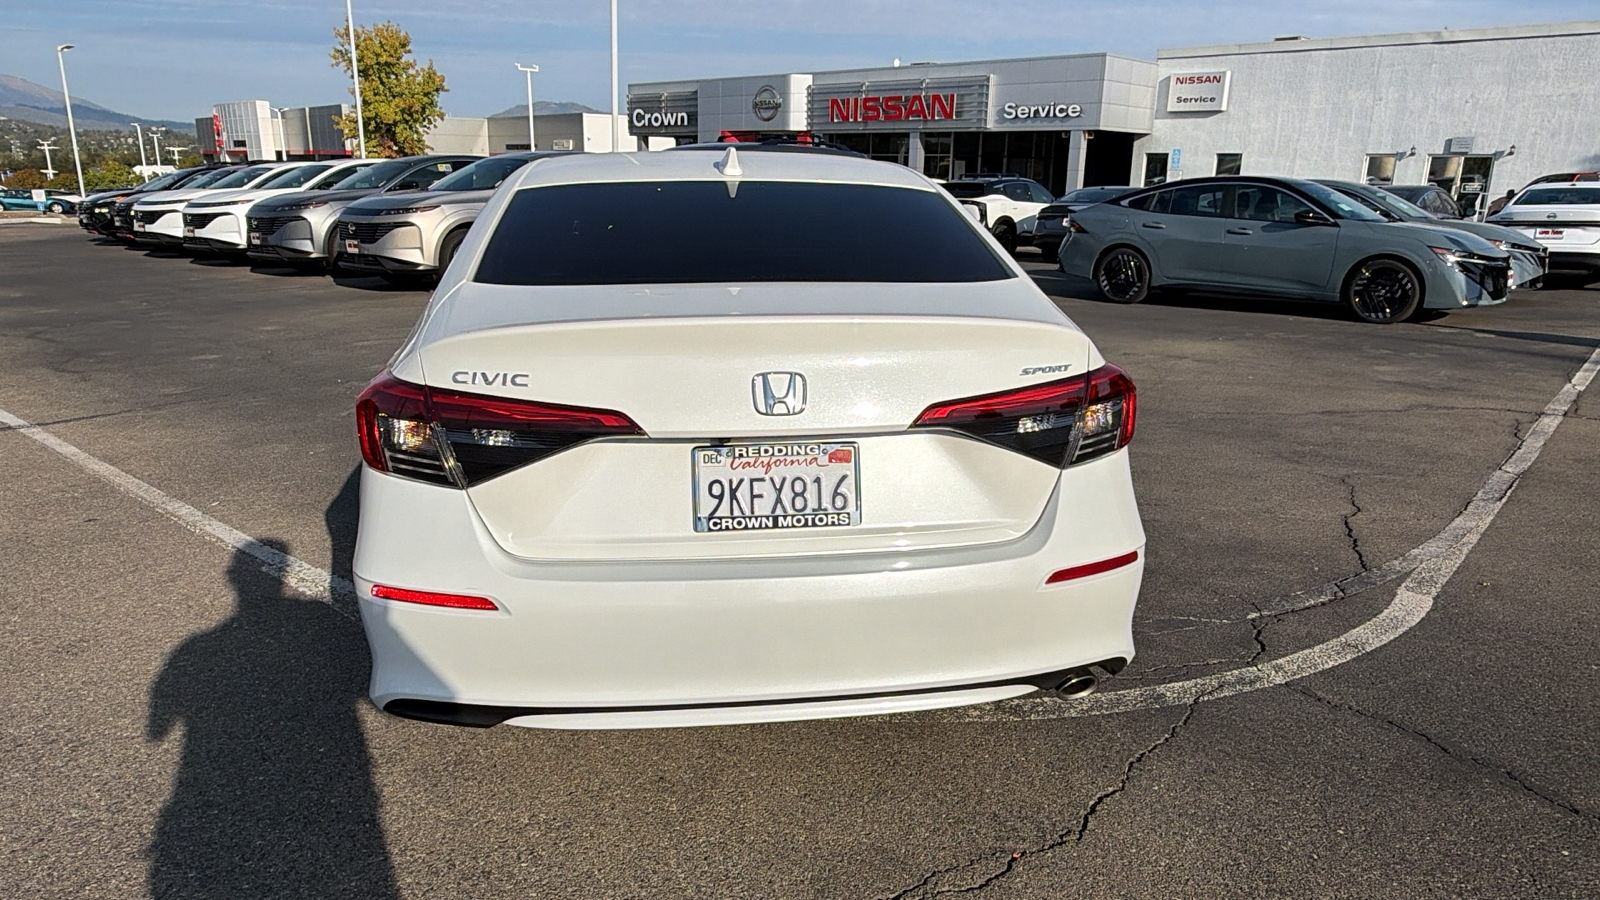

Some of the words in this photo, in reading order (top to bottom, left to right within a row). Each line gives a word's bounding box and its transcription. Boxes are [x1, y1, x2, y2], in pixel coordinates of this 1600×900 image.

[1175, 74, 1222, 86] NISSAN
[829, 93, 957, 123] NISSAN
[1175, 95, 1217, 105] Service
[632, 107, 689, 128] Crown
[1003, 101, 1082, 119] Service
[1019, 364, 1072, 376] SPORT
[452, 371, 529, 387] CIVIC
[703, 453, 722, 464] DEC
[735, 445, 820, 457] REDDING
[730, 456, 829, 475] California
[708, 474, 850, 516] 9KFX816
[709, 516, 773, 530] CROWN
[777, 514, 850, 528] MOTORS
